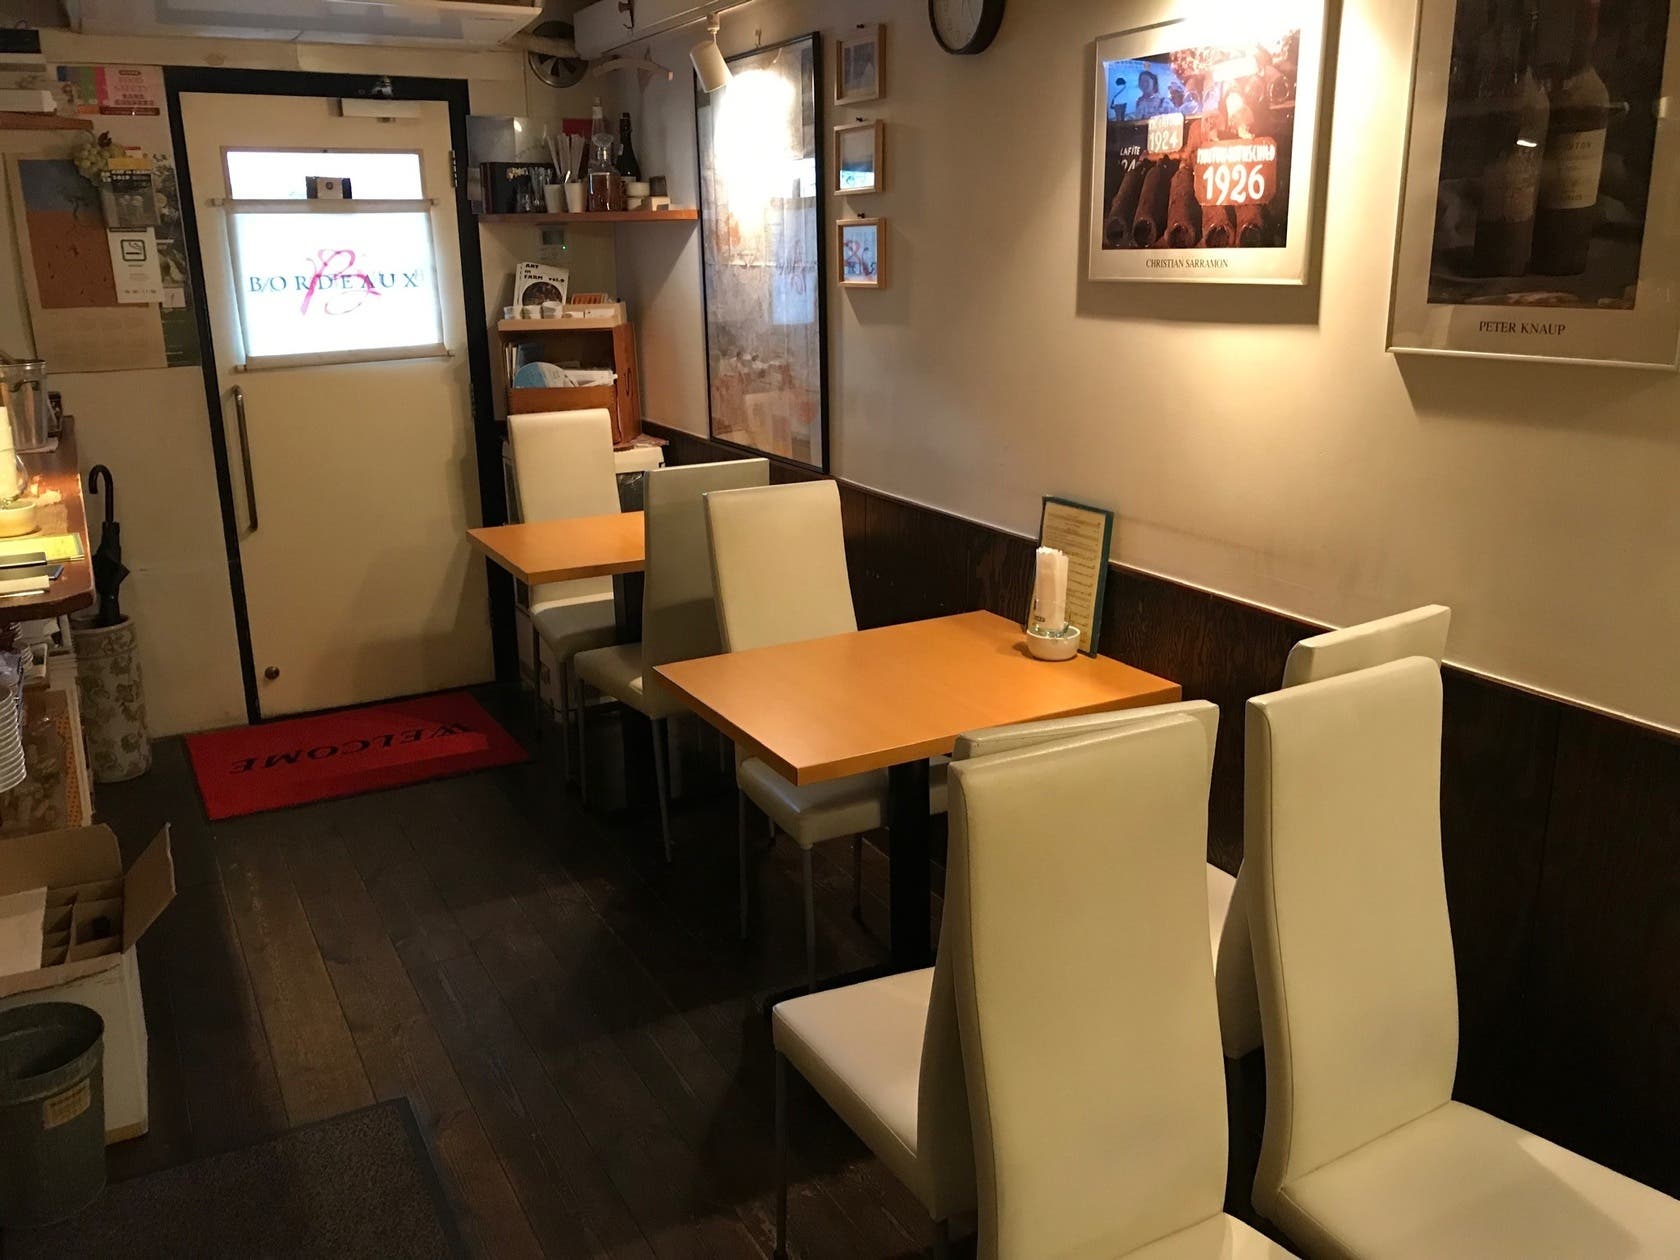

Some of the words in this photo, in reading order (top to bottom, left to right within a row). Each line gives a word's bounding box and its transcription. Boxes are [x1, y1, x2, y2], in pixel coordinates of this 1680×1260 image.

[1149, 130, 1178, 153] 1924
[1202, 164, 1265, 206] 1926
[1145, 258, 1184, 269] CHRISTIAN
[1185, 259, 1229, 269] SARRAMON
[249, 272, 420, 293] BORDEAUX
[1479, 320, 1516, 333] PETER
[1520, 322, 1566, 336] KNAUP
[229, 722, 474, 775] WELCOME
